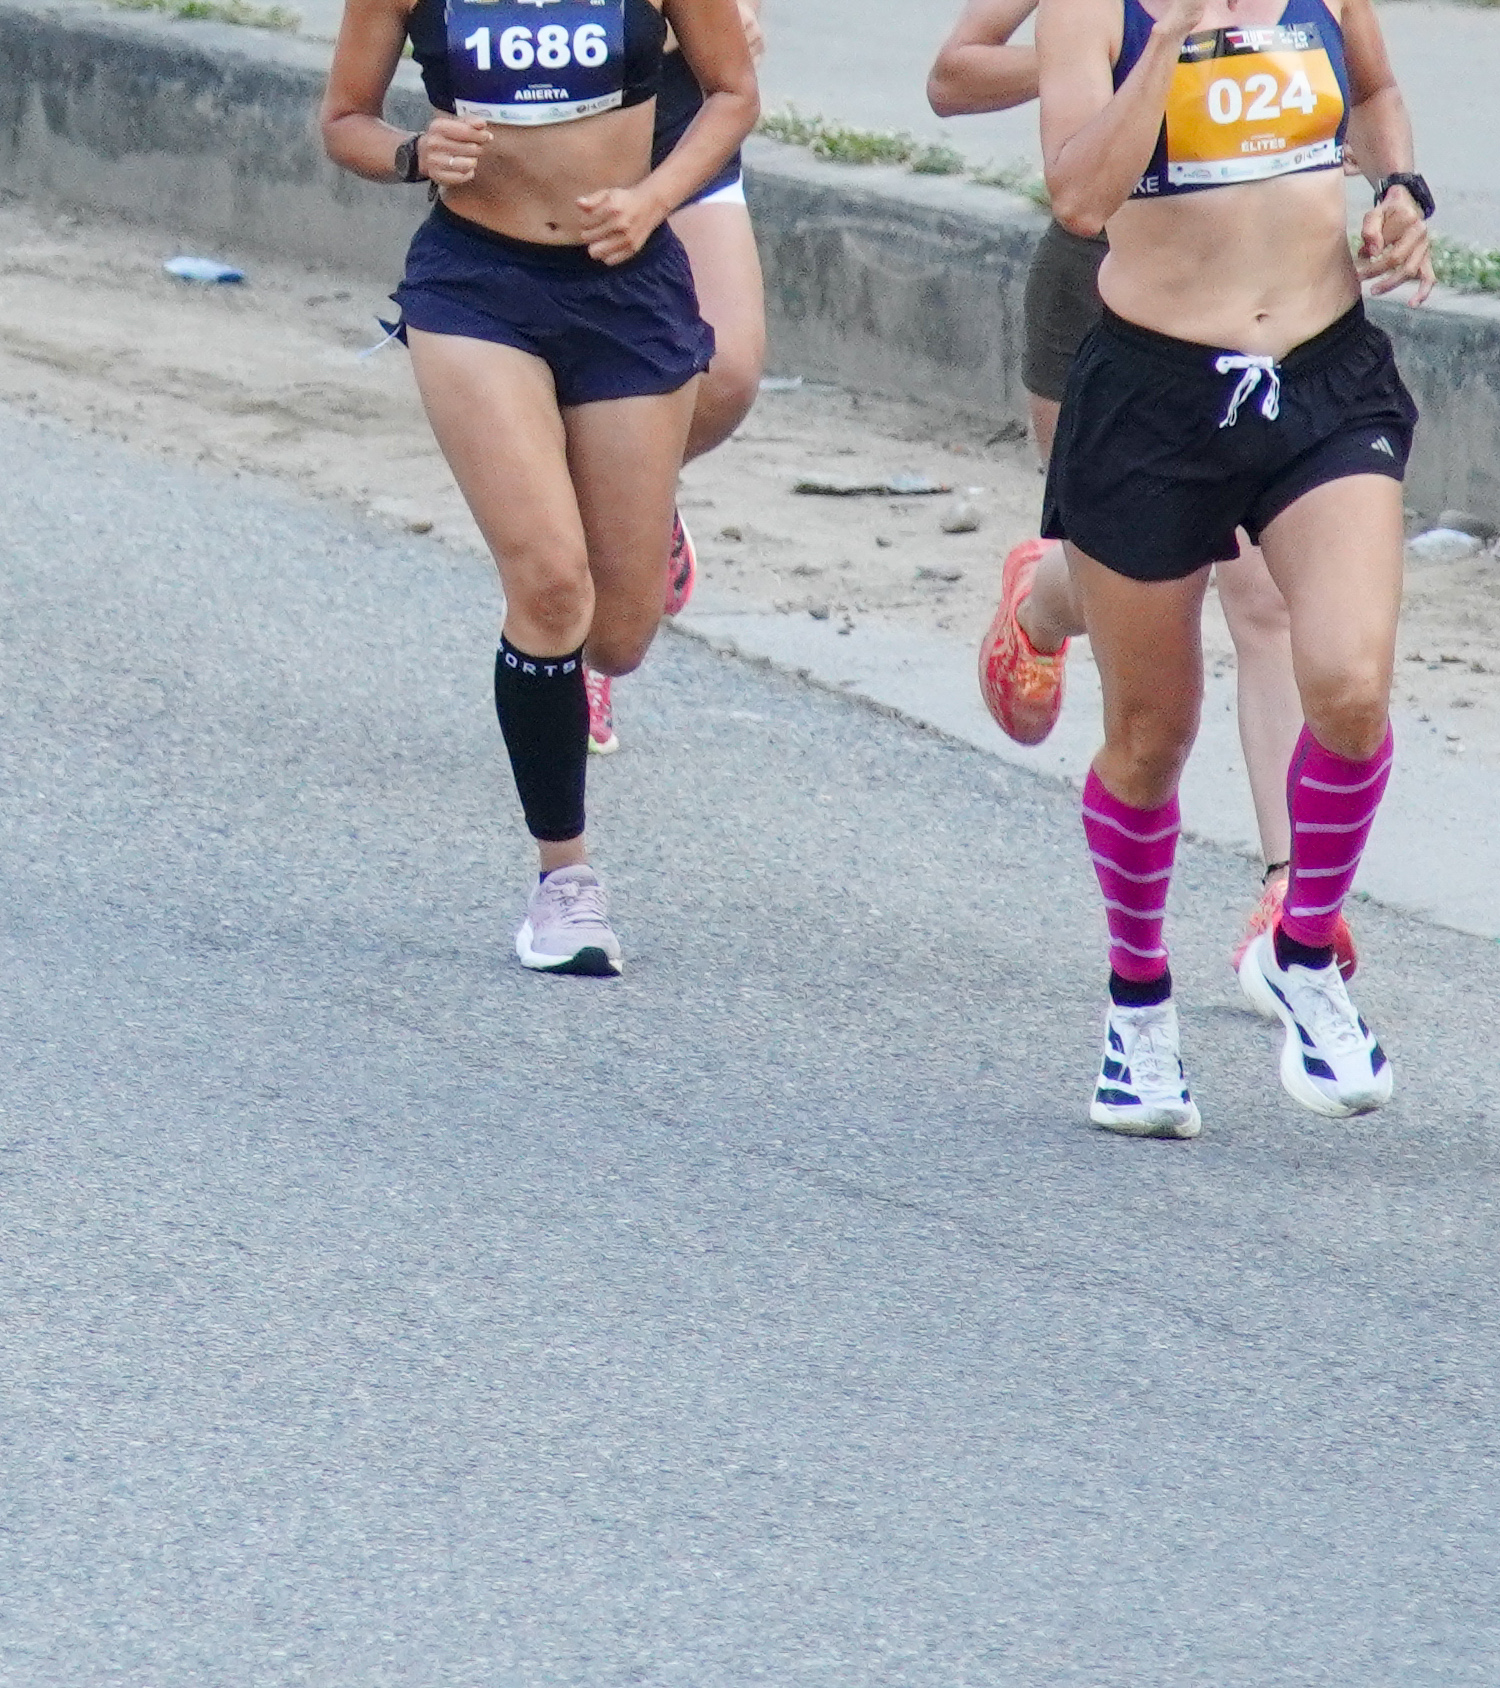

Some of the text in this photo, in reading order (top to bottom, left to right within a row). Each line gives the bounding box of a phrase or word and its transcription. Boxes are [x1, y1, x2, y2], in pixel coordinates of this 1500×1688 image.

[464, 23, 608, 70] 1686
[514, 88, 569, 101] ABIERTA
[1207, 69, 1318, 125] 024
[499, 649, 577, 678] ORTS
